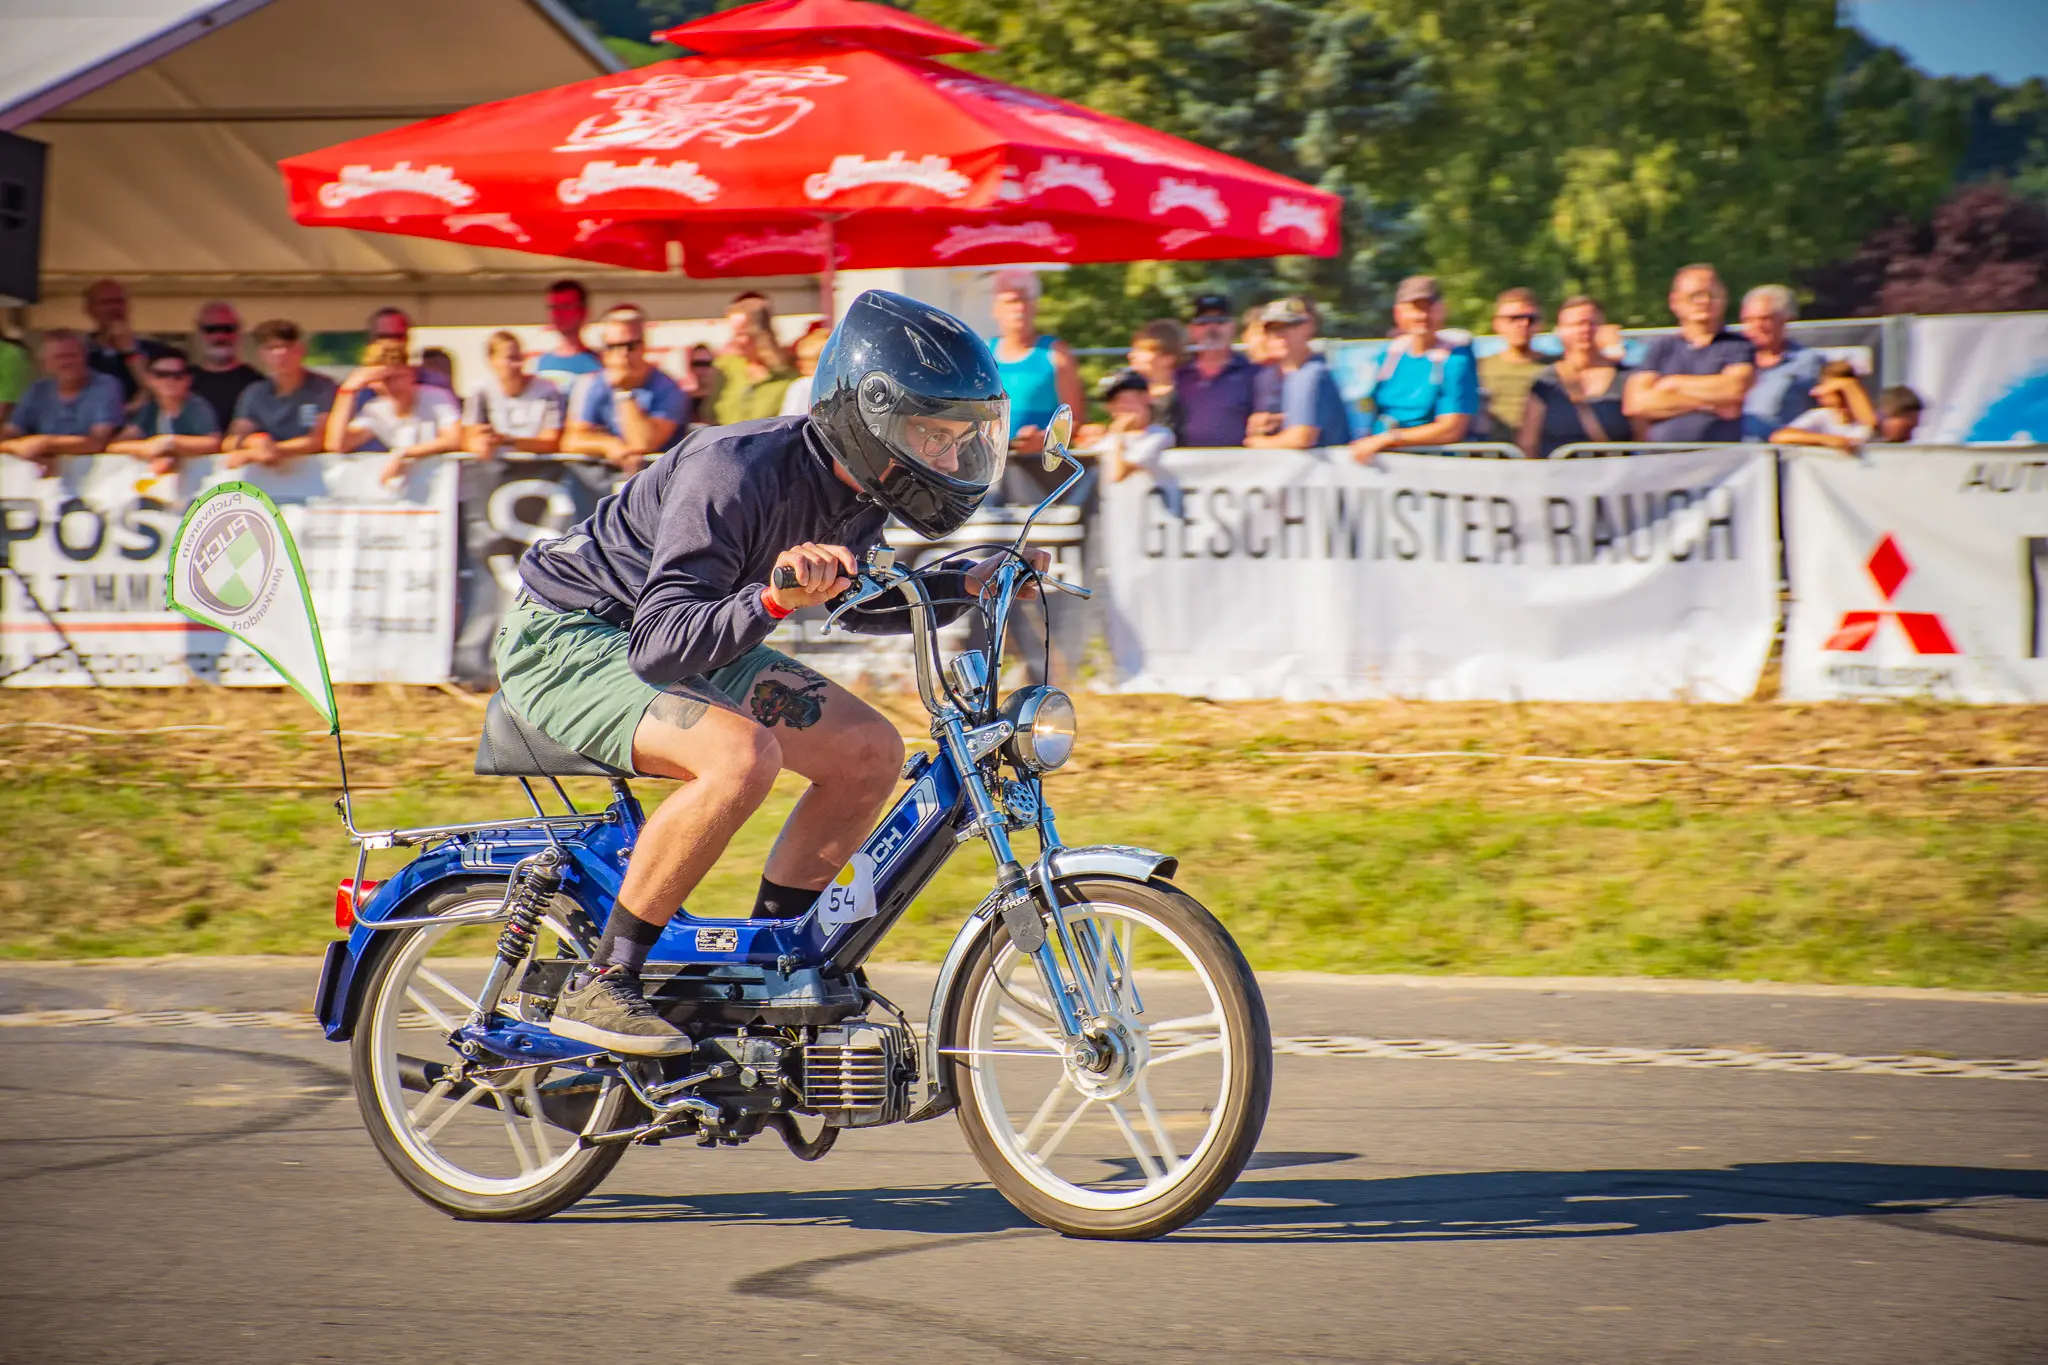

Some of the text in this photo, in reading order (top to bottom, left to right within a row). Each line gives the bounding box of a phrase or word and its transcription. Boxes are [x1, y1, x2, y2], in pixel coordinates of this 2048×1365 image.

[1141, 486, 1739, 565] GESCHWISTER RAUCH
[829, 887, 856, 912] 54
